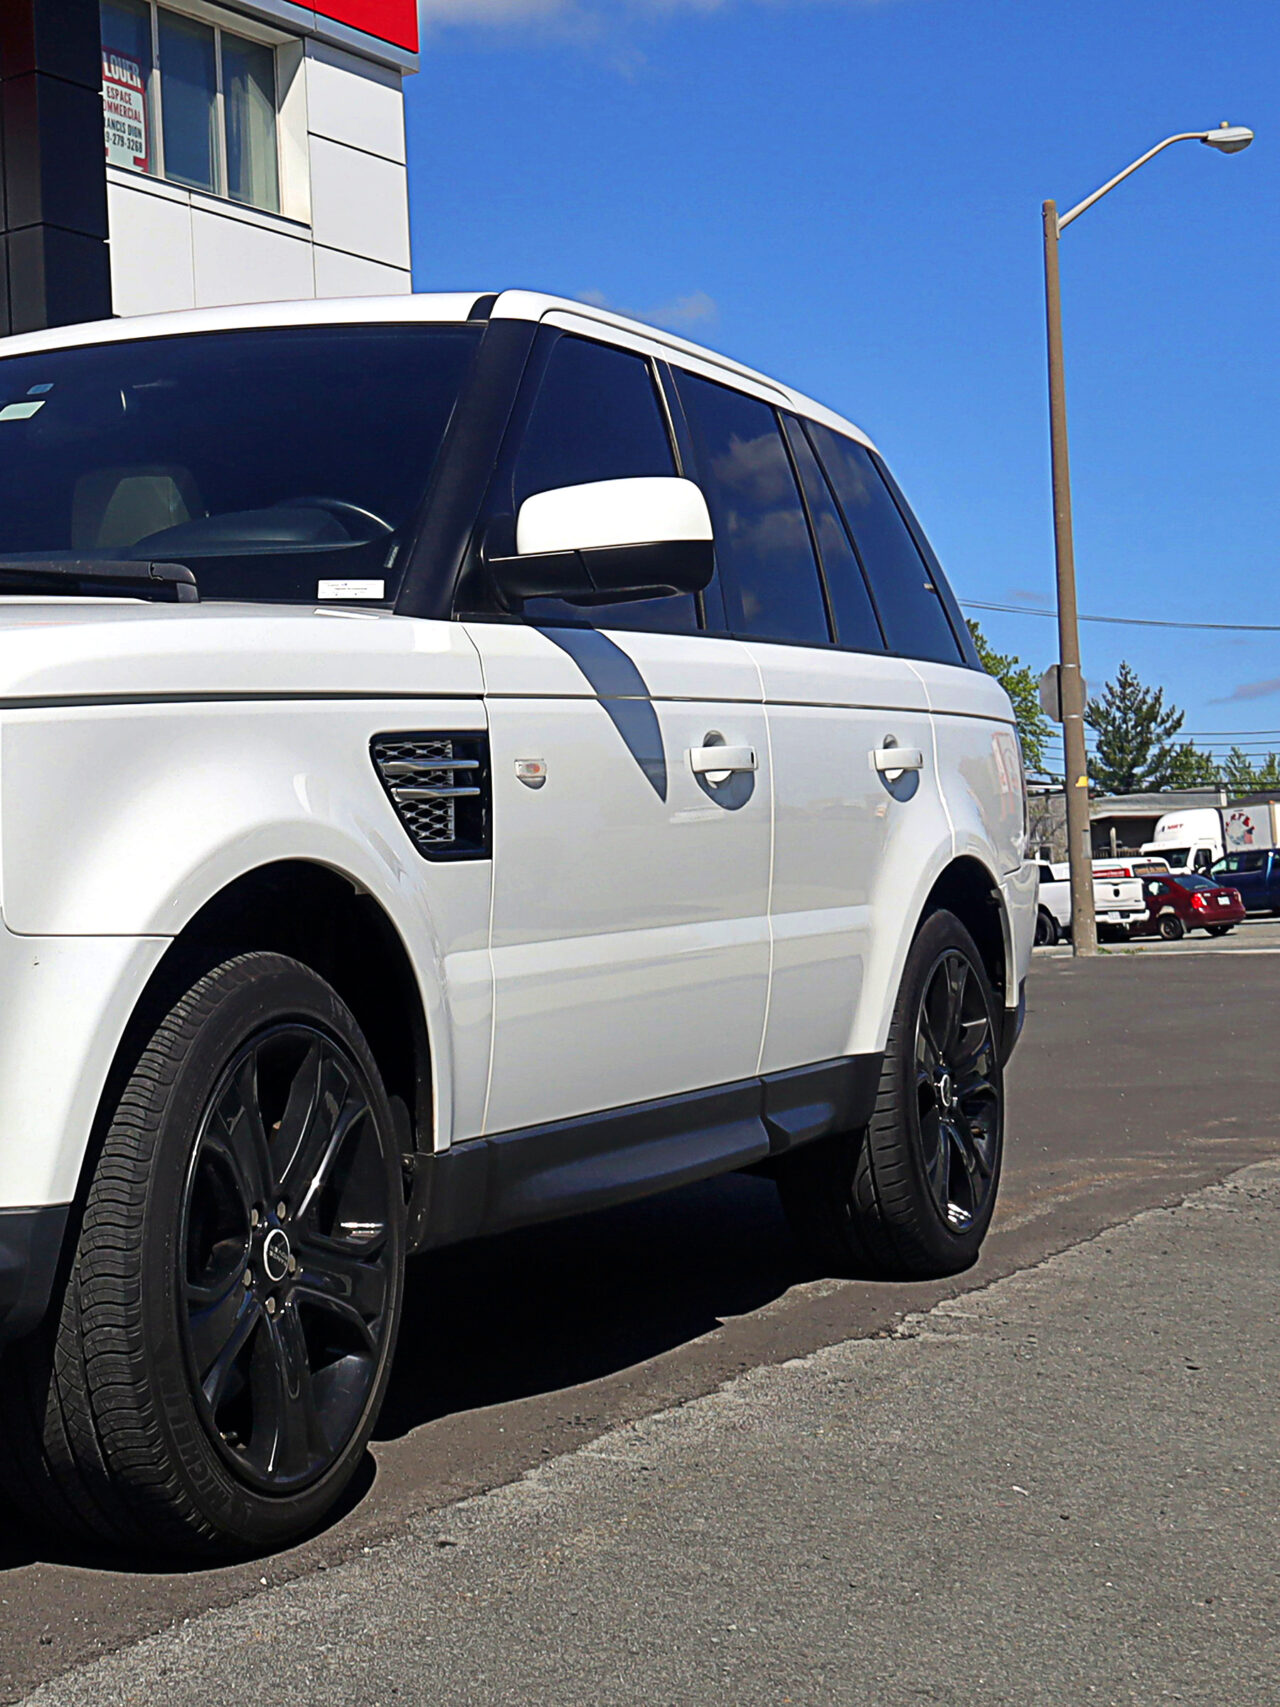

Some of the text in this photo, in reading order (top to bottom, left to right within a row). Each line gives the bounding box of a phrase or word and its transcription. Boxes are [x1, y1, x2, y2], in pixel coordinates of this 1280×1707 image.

[106, 86, 132, 105] ESPACE
[103, 100, 142, 123] OMMERCIAL
[106, 117, 126, 134] ANCIS
